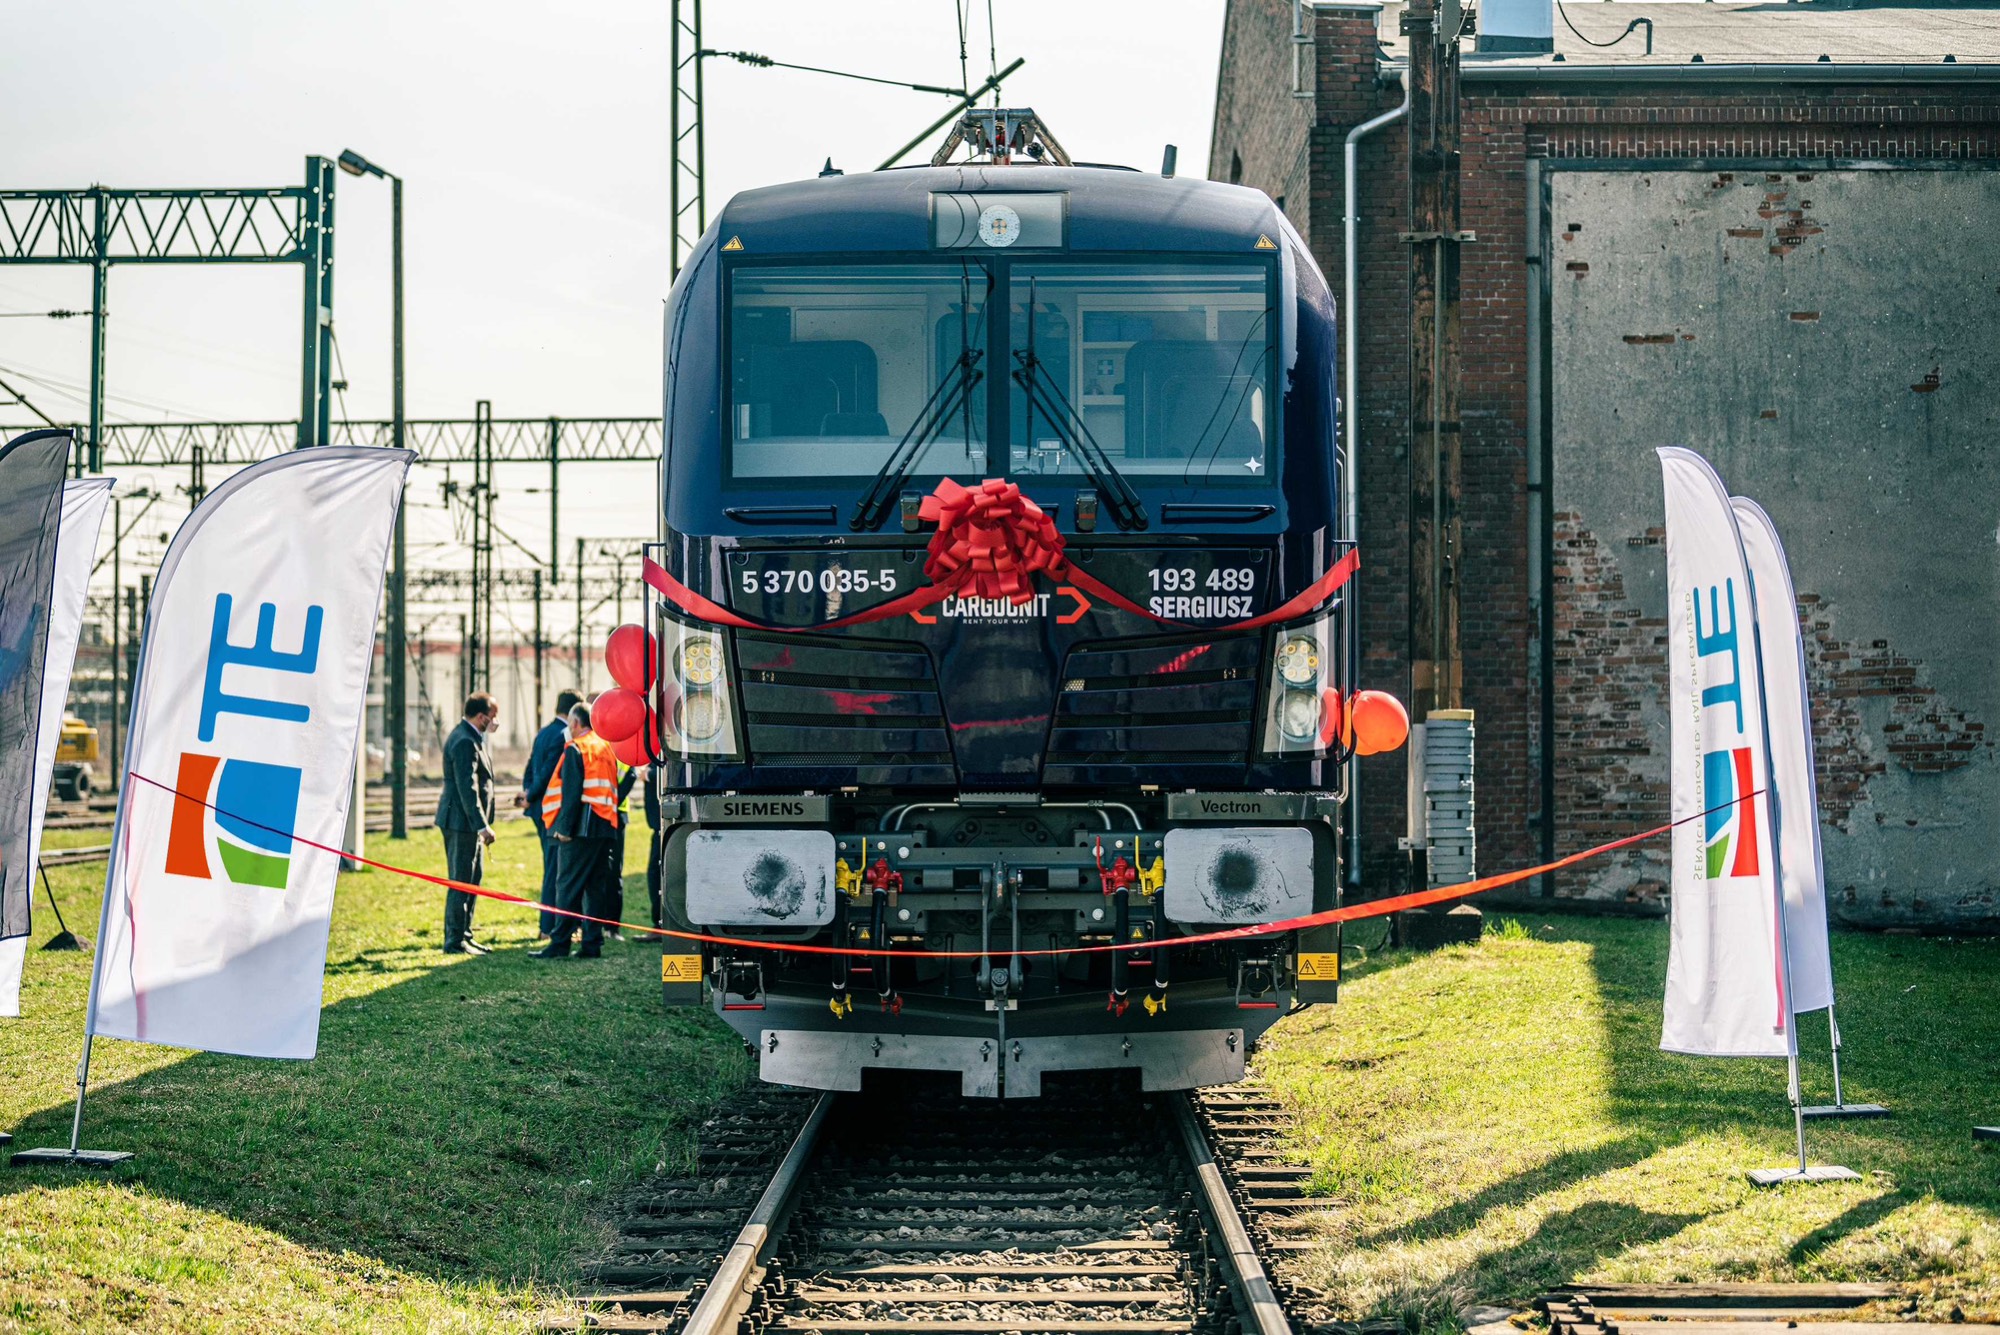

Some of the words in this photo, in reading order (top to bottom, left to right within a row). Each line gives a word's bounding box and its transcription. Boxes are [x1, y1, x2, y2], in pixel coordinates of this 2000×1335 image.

[742, 570, 759, 594] 5
[764, 570, 814, 594] 370
[819, 569, 897, 593] 035-5
[1148, 568, 1196, 592] 193
[1205, 568, 1255, 592] 489
[1149, 596, 1253, 618] SERGIUSZ
[723, 802, 805, 816] SIEMENS
[1200, 800, 1261, 813] Vectron
